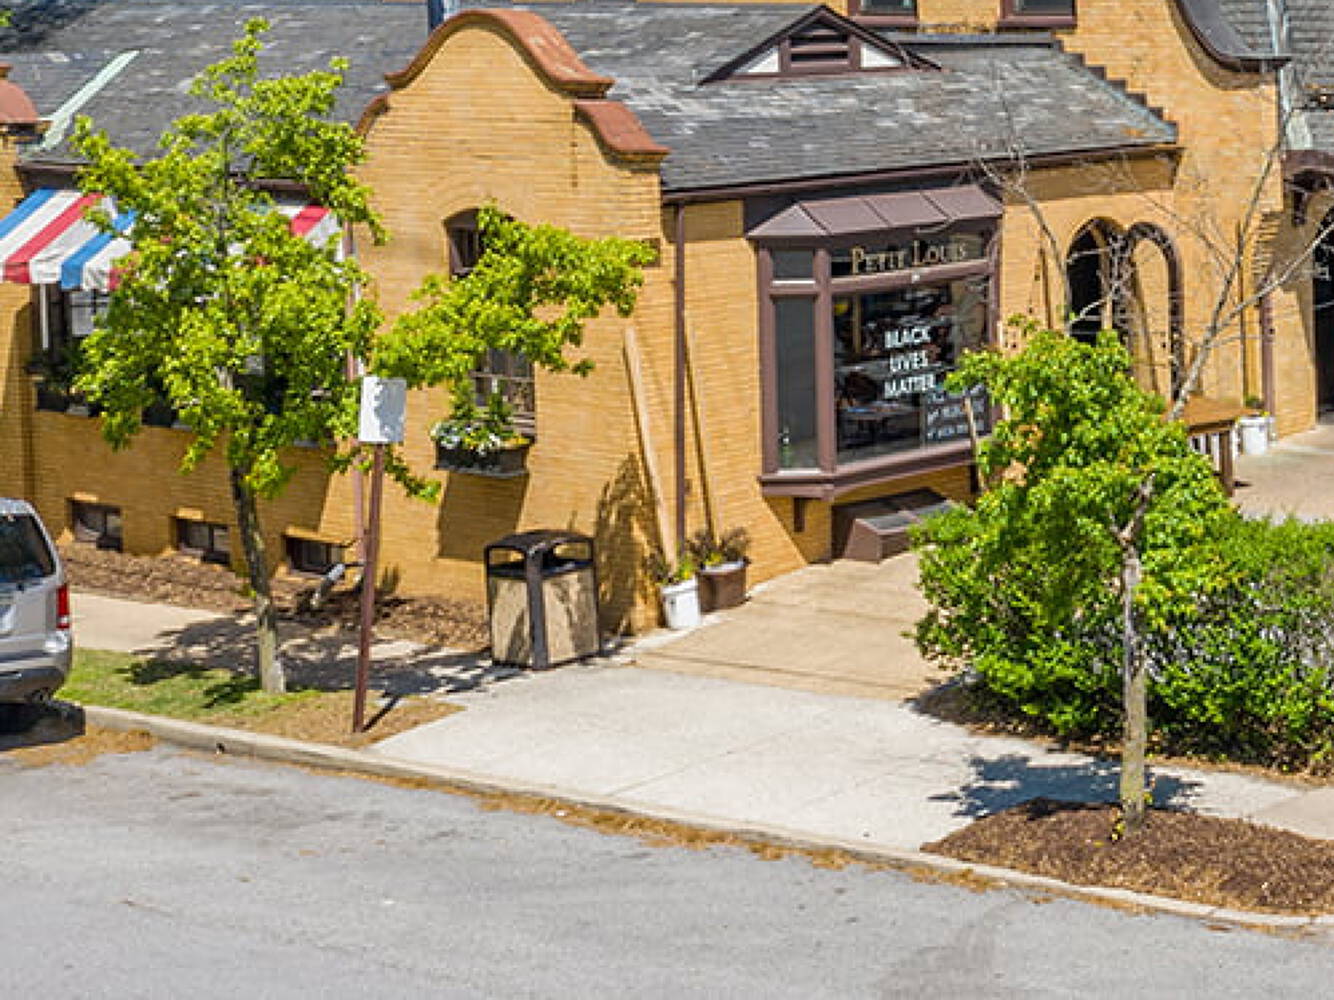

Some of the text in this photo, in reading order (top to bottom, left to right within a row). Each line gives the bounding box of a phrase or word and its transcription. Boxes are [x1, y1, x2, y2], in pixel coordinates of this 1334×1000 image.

[884, 325, 932, 349] BLACK
[889, 350, 928, 373] LIVES
[884, 373, 937, 399] MATTER
